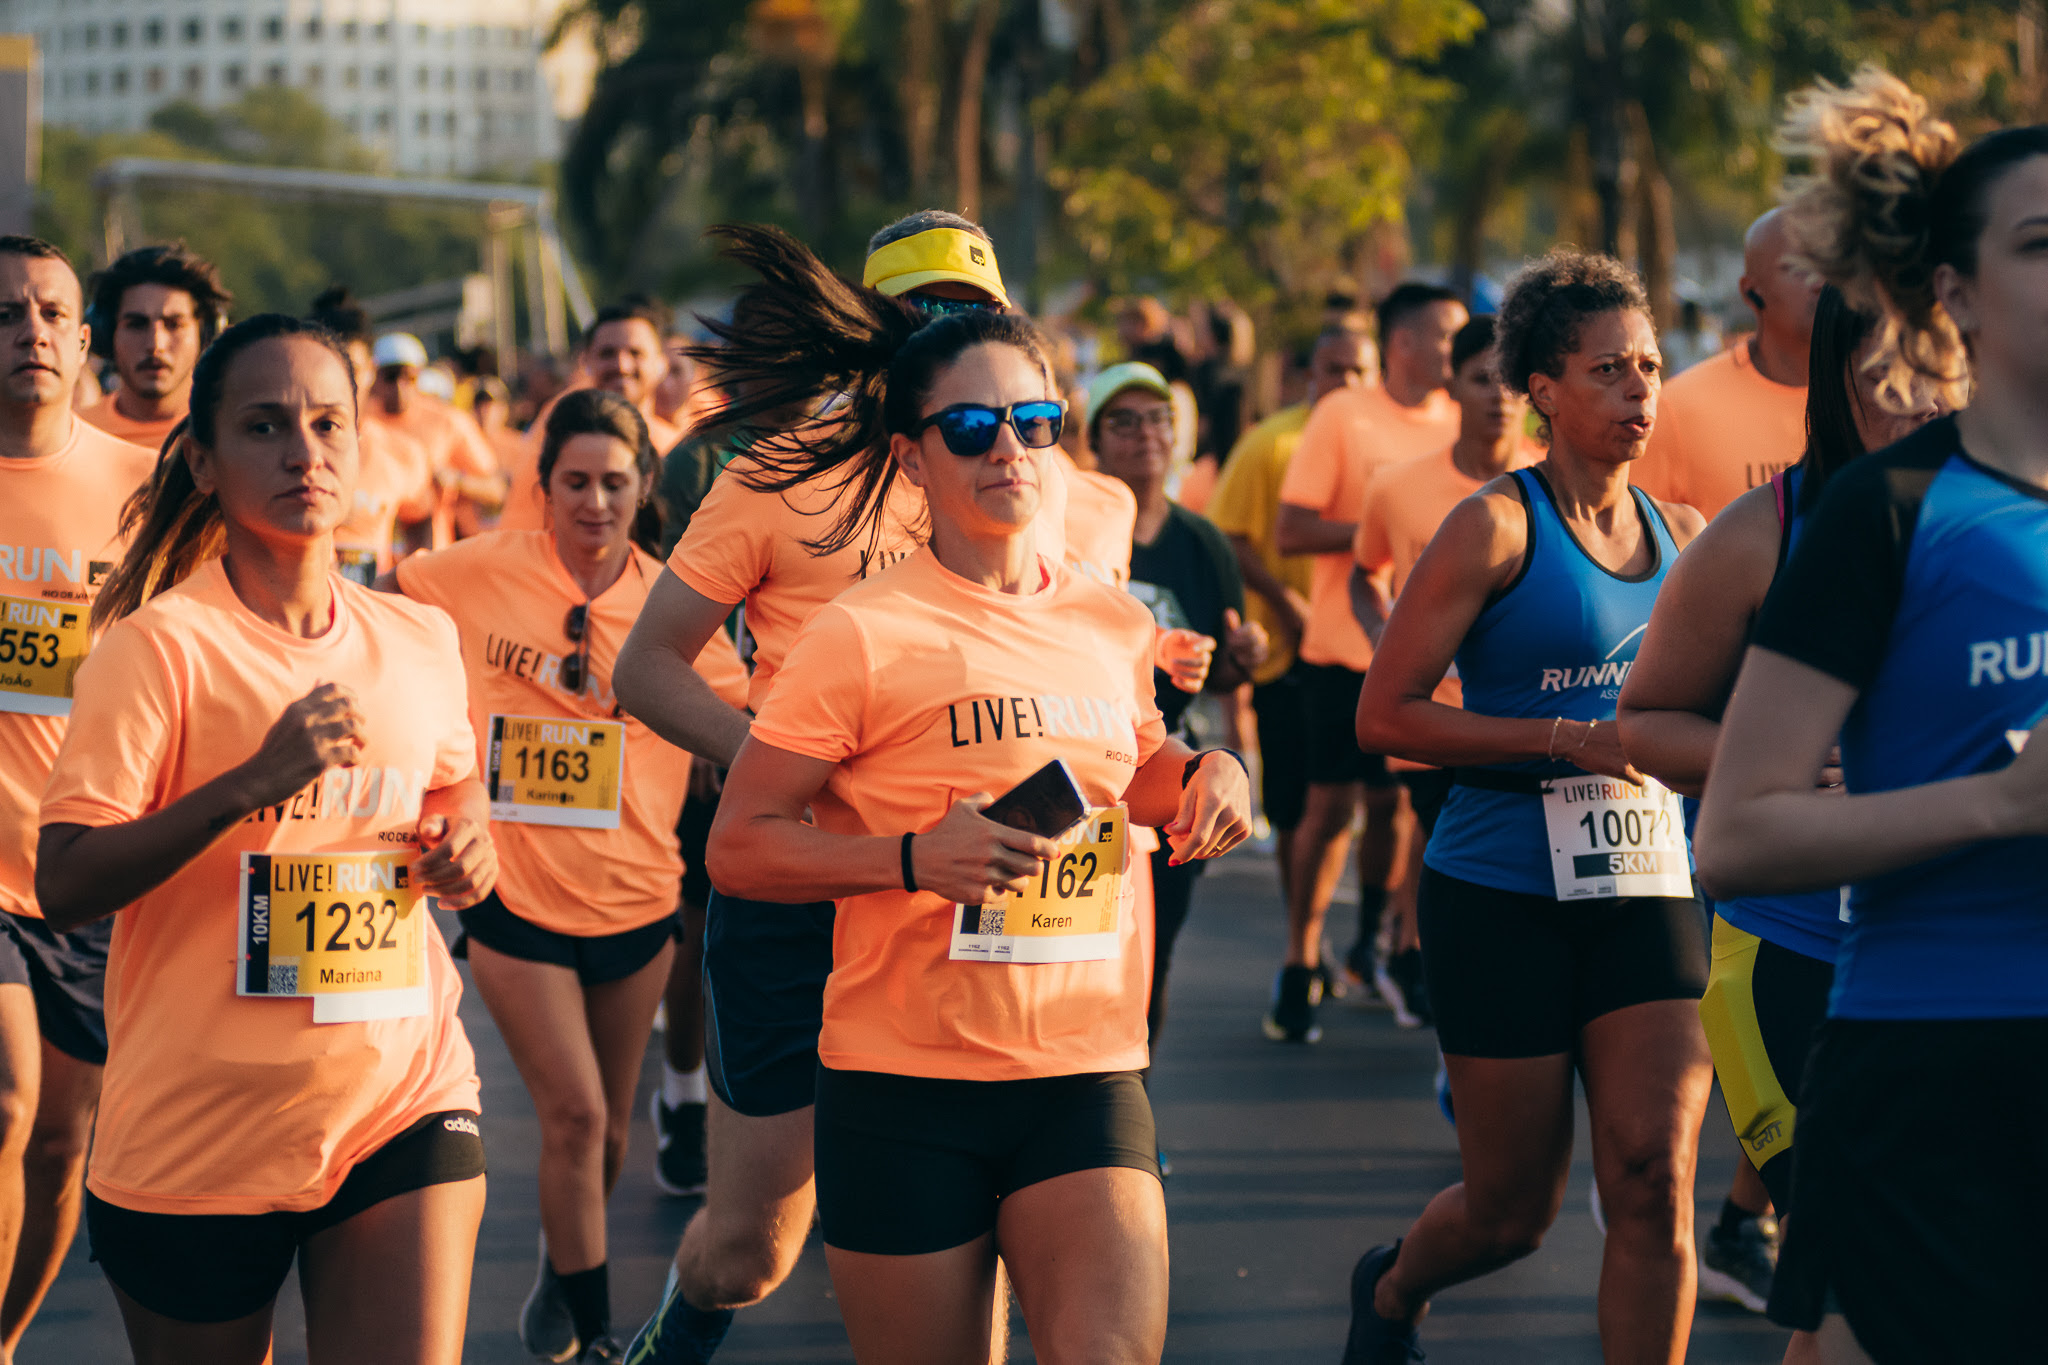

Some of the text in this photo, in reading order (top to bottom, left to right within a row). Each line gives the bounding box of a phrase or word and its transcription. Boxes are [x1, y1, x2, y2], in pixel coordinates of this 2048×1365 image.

[1541, 660, 1635, 692] RUNN
[515, 746, 590, 783] 1163
[1105, 750, 1122, 762] RIO
[378, 831, 394, 842] RIO
[1015, 851, 1098, 899] 162
[1609, 853, 1657, 874] 5KM
[252, 894, 269, 946] 10KM
[296, 899, 398, 952] 1232
[1031, 913, 1072, 928] Karen
[320, 967, 382, 984] Mariana
[1751, 1120, 1782, 1152] GRIT
